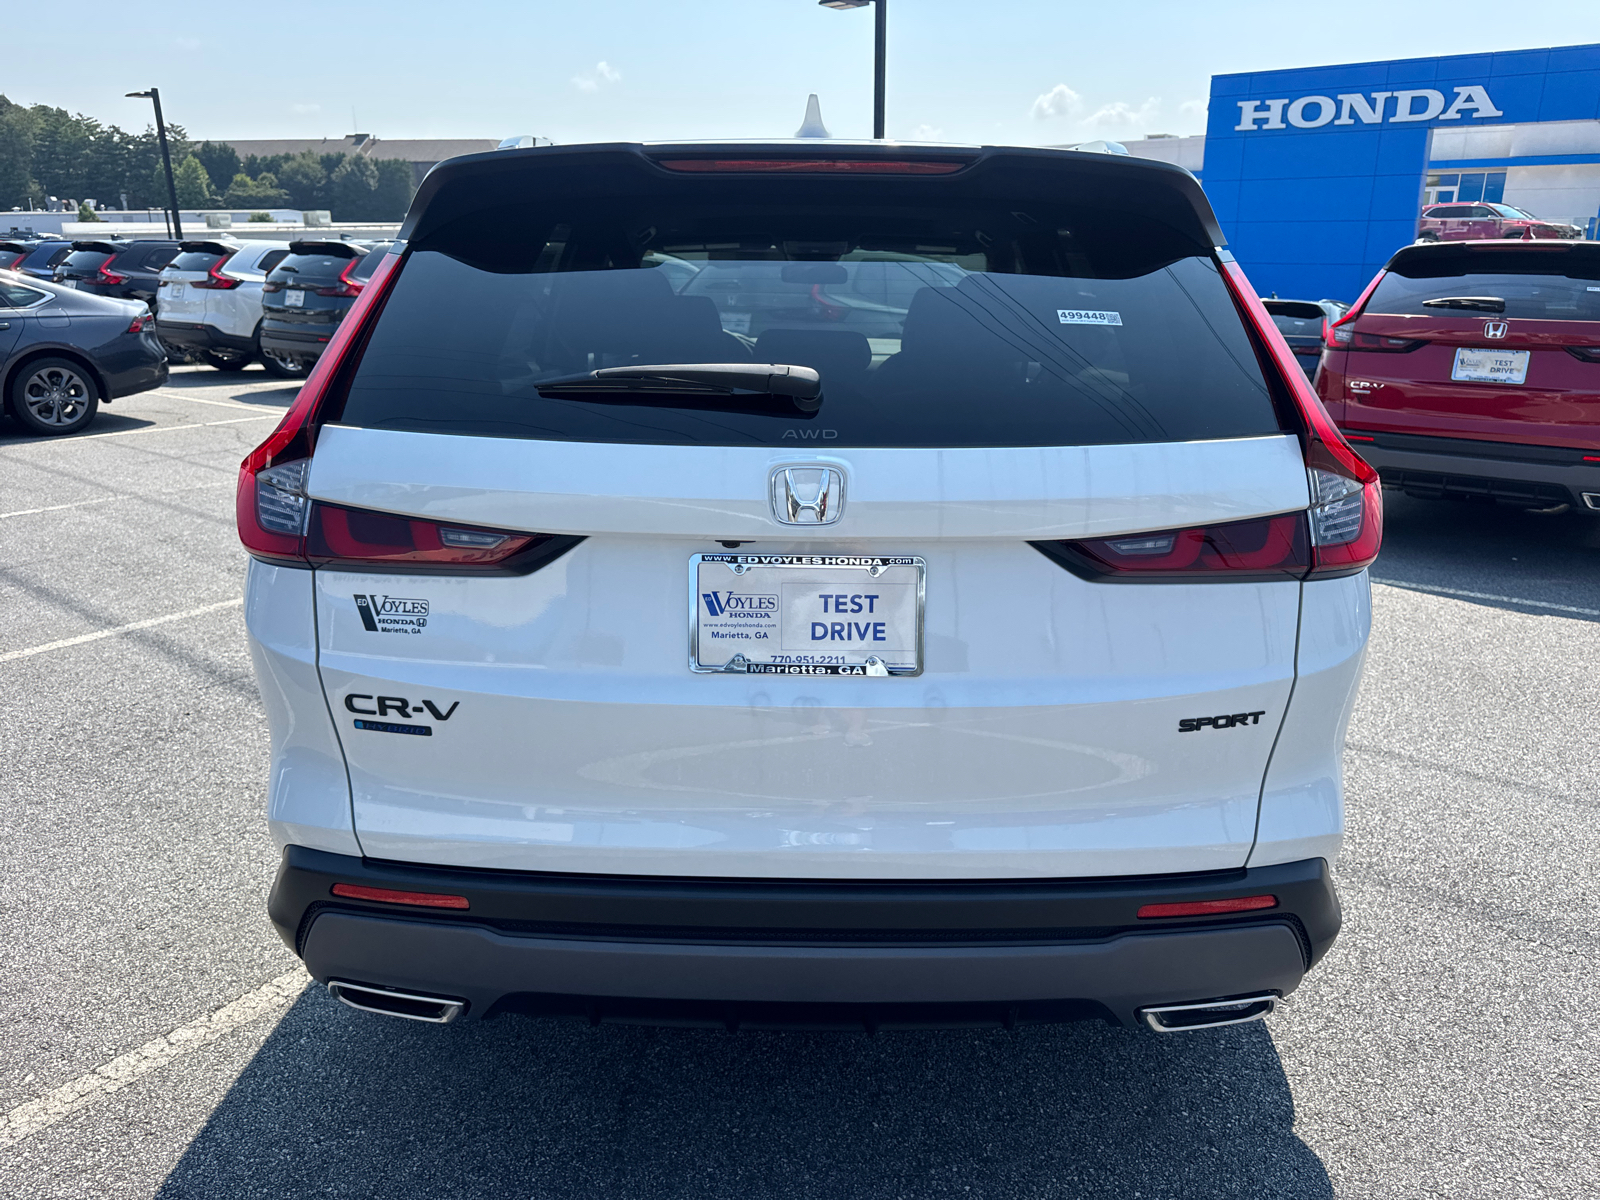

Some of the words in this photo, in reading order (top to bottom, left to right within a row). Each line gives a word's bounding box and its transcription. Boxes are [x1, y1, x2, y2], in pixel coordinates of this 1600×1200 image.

[1234, 85, 1503, 131] HONDA
[1060, 311, 1106, 320] 499448
[1494, 359, 1514, 367] TEST
[1490, 367, 1515, 375] DRIVE
[781, 429, 838, 439] AWD
[357, 598, 368, 607] ED
[369, 594, 428, 617] VOYLES
[711, 591, 776, 614] VOYLES
[818, 594, 880, 613] TEST
[377, 618, 416, 626] HONDA
[381, 627, 410, 635] Marietta,
[711, 631, 752, 640] Marietta,
[811, 622, 886, 641] DRIVE
[770, 655, 846, 664] 770-951-2211
[750, 664, 831, 675] Marietta,
[838, 666, 864, 675] GA
[344, 693, 461, 721] CR-V
[1178, 711, 1266, 732] SPORT
